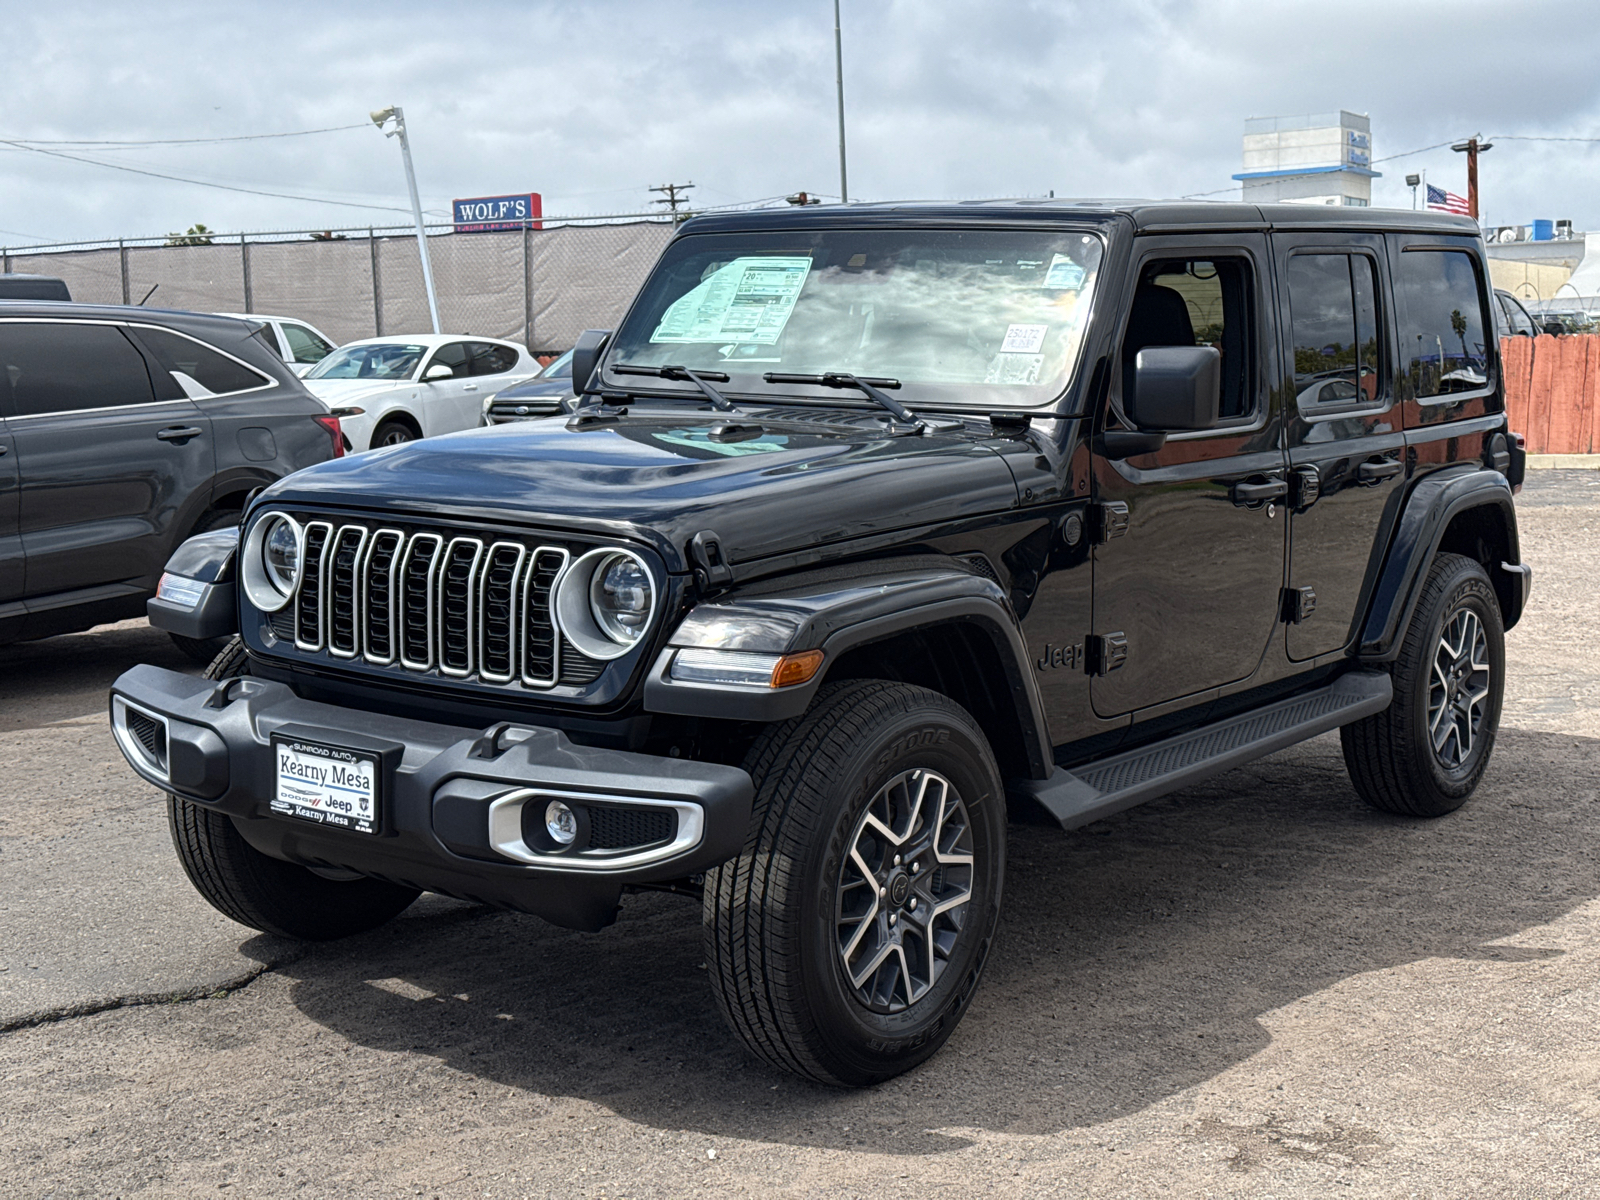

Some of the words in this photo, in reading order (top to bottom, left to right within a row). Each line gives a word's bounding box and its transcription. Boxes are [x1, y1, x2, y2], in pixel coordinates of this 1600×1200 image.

[459, 199, 526, 221] WOLF'S
[1038, 643, 1084, 671] Jeep
[292, 743, 330, 757] SUNROAD
[331, 751, 352, 761] AUTO
[280, 754, 327, 787] Kearny
[331, 765, 370, 790] Mesa
[325, 794, 353, 813] Jeep
[295, 805, 325, 823] Kearny
[326, 812, 348, 826] Mesa
